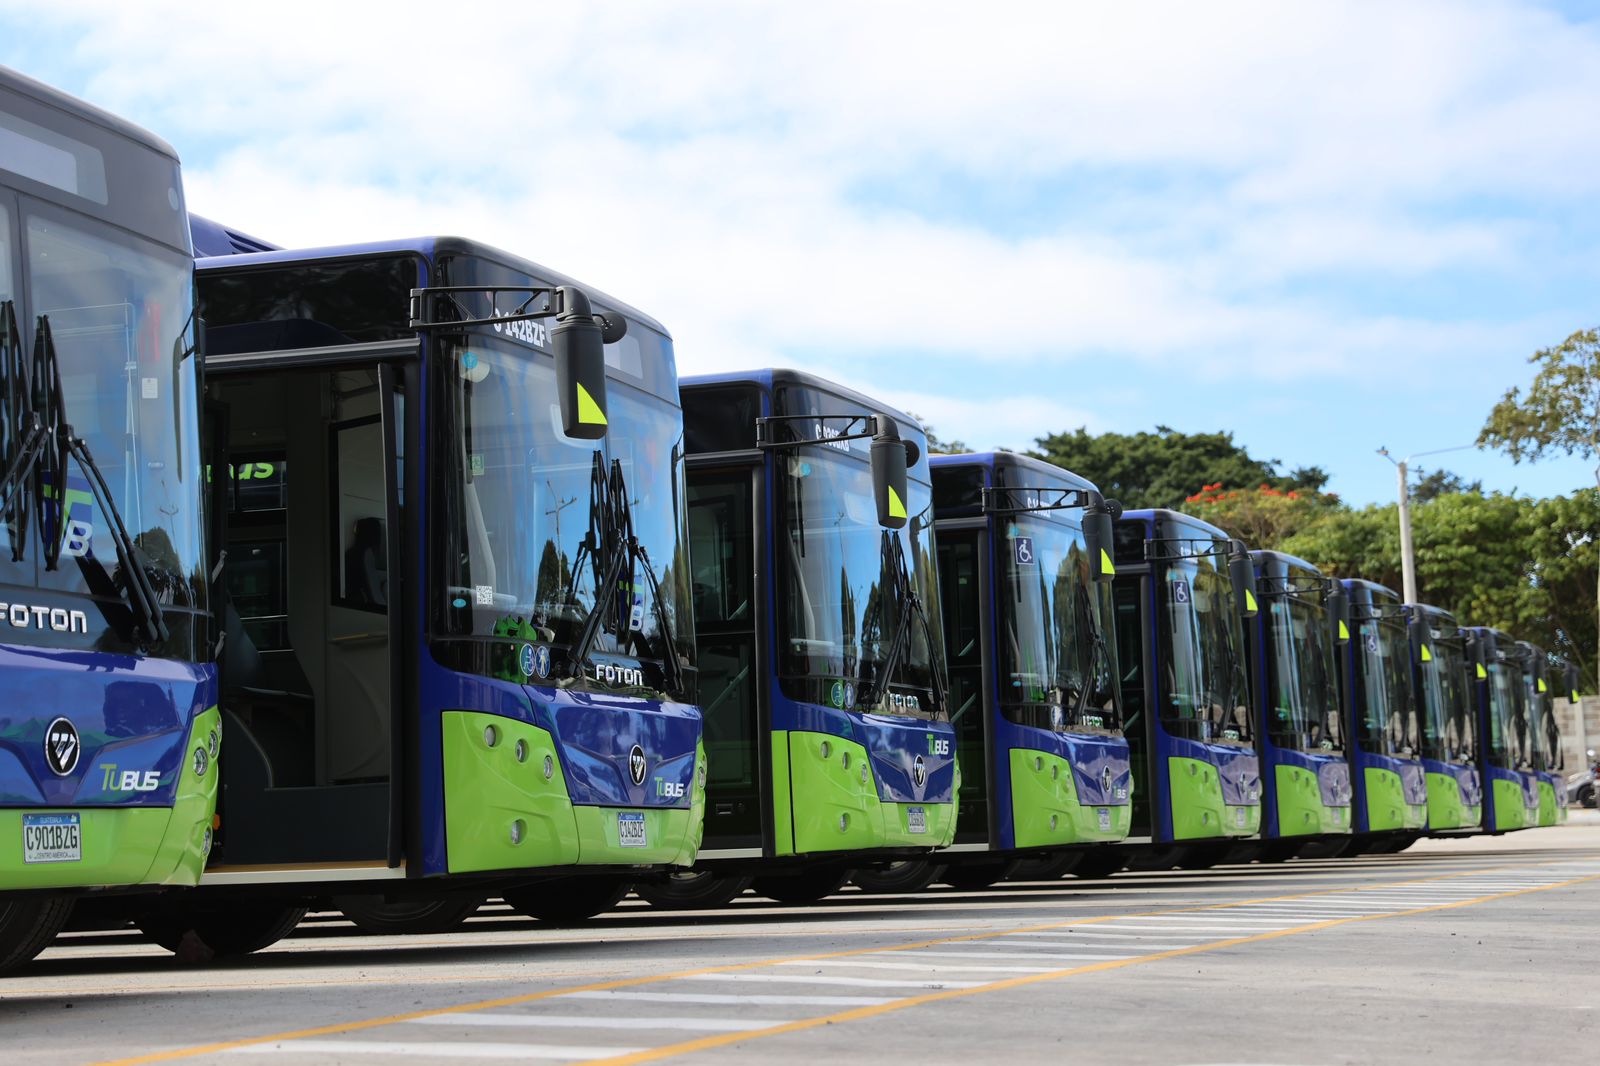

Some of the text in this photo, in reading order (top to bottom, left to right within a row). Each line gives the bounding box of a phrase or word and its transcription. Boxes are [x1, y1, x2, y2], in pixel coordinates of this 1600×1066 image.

[505, 310, 545, 348] 142BZF
[0, 603, 88, 634] OTON
[596, 664, 643, 686] FOTON
[26, 825, 78, 850] C901BZG
